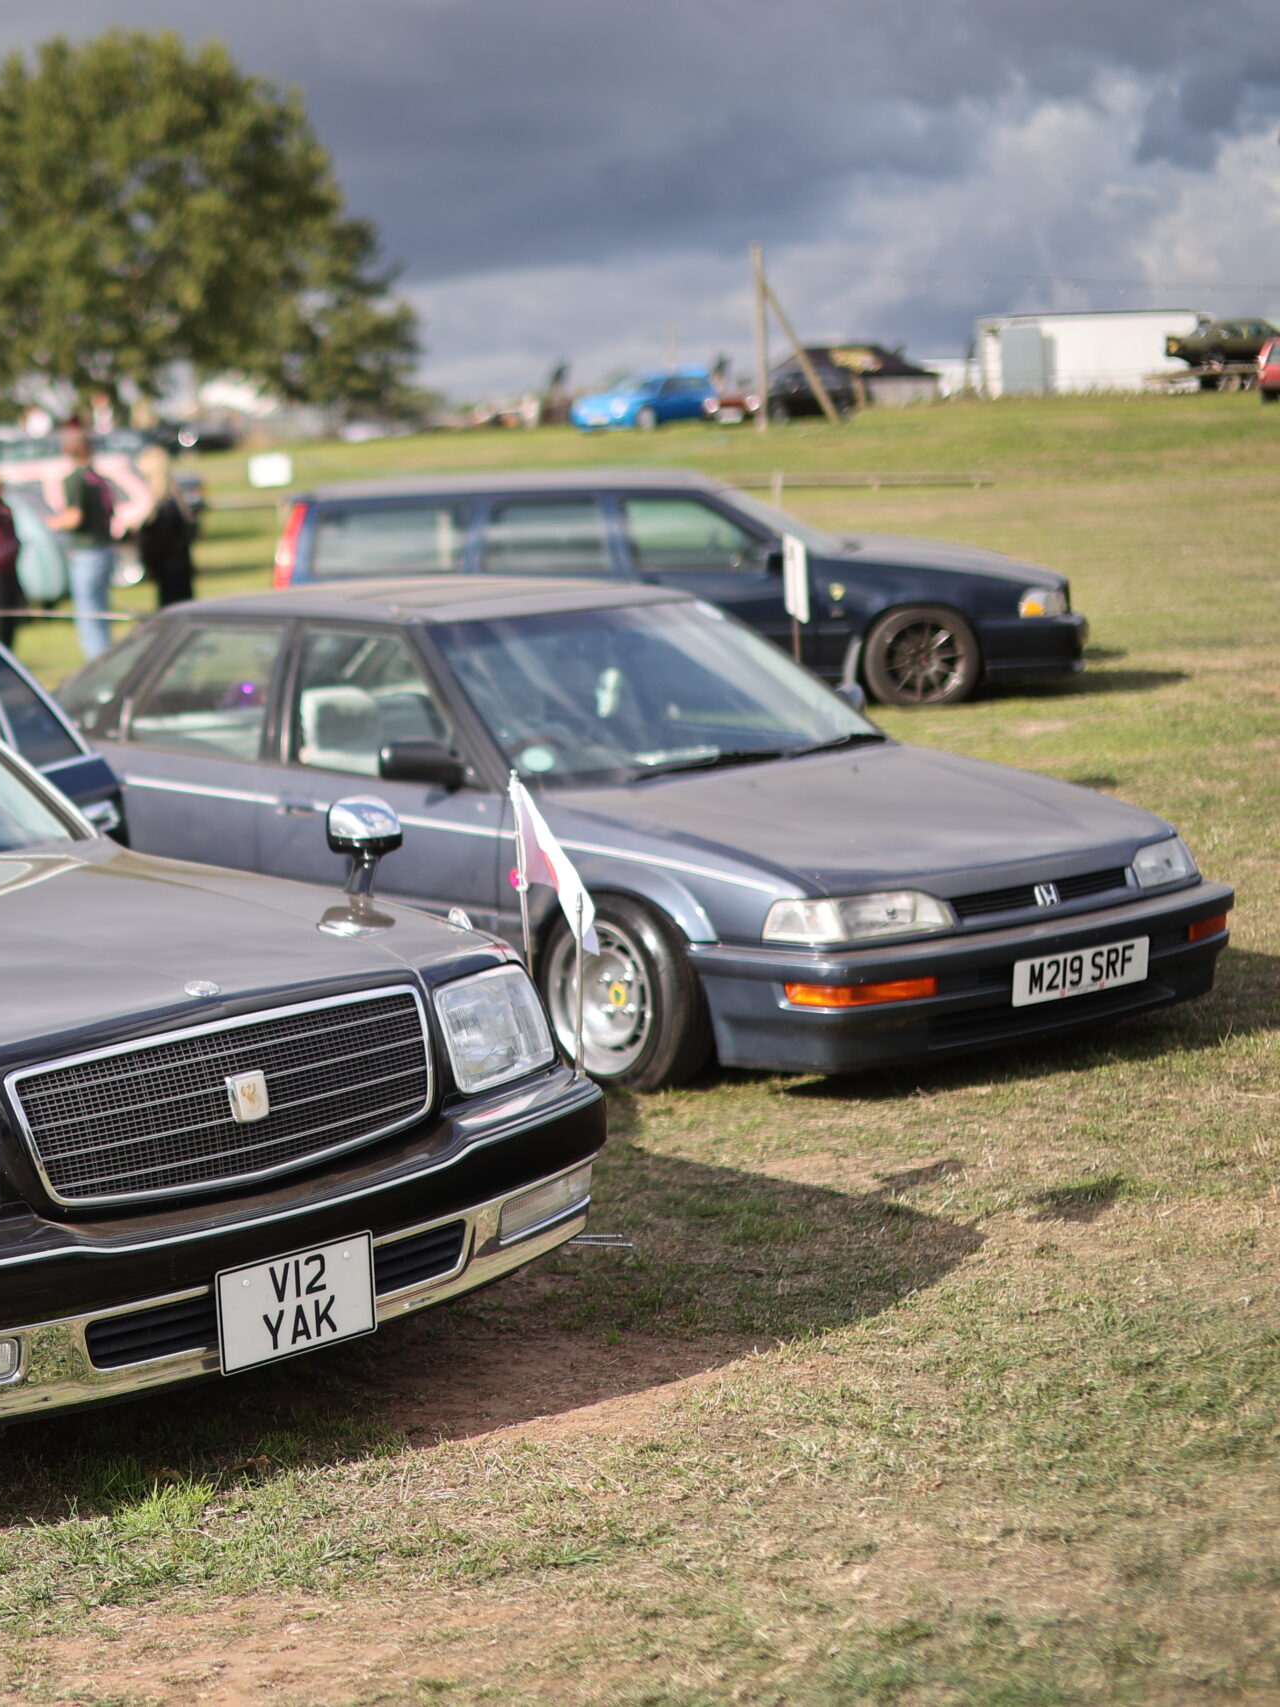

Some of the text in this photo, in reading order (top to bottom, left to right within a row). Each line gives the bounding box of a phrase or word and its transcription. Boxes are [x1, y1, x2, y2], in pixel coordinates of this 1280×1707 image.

[1028, 943, 1136, 996] M219 SRF
[268, 1253, 327, 1303] V12
[262, 1294, 338, 1350] YAK
